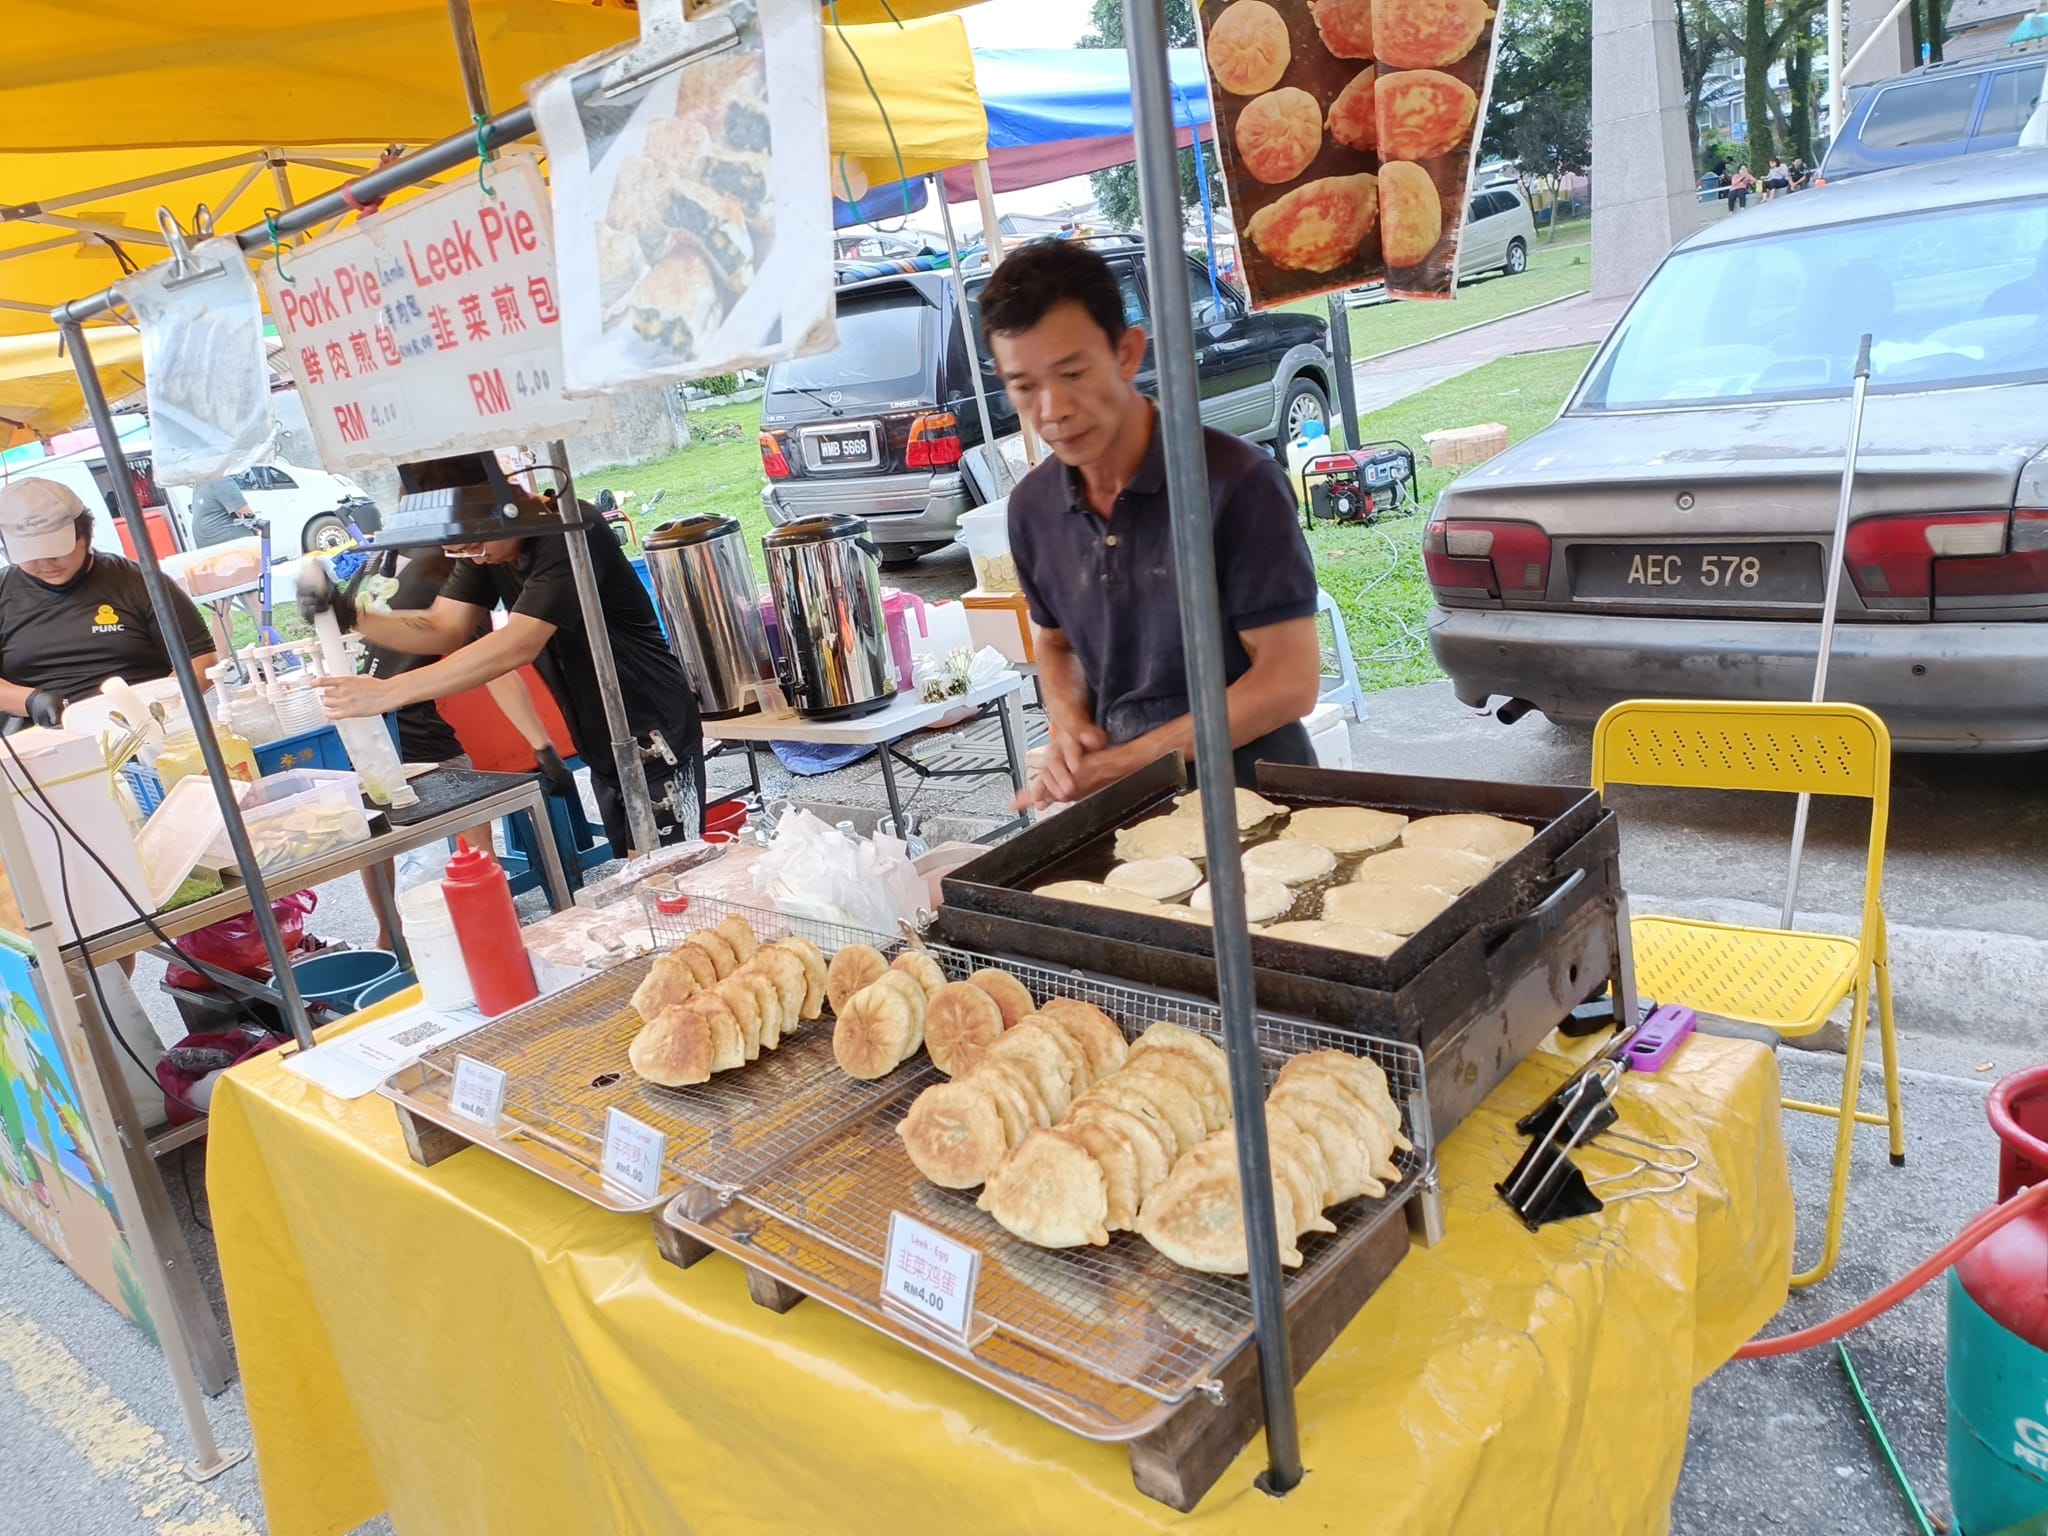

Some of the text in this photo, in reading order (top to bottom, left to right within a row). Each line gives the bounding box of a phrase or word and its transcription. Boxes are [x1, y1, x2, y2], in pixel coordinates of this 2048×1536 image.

[404, 201, 538, 288] Leek Pie
[280, 263, 382, 334] Pork Pie
[427, 275, 560, 352] 韭菜煎包
[300, 323, 403, 385] 鲜肉煎包
[468, 368, 550, 417] RM 4.00
[333, 402, 397, 443] RM 4.00
[841, 439, 867, 455] 5668
[1627, 554, 1760, 587] AEC 578
[91, 624, 125, 634] PUNC
[898, 1247, 958, 1298] 韭菜鸡蛋
[903, 1280, 945, 1312] RM4.00
